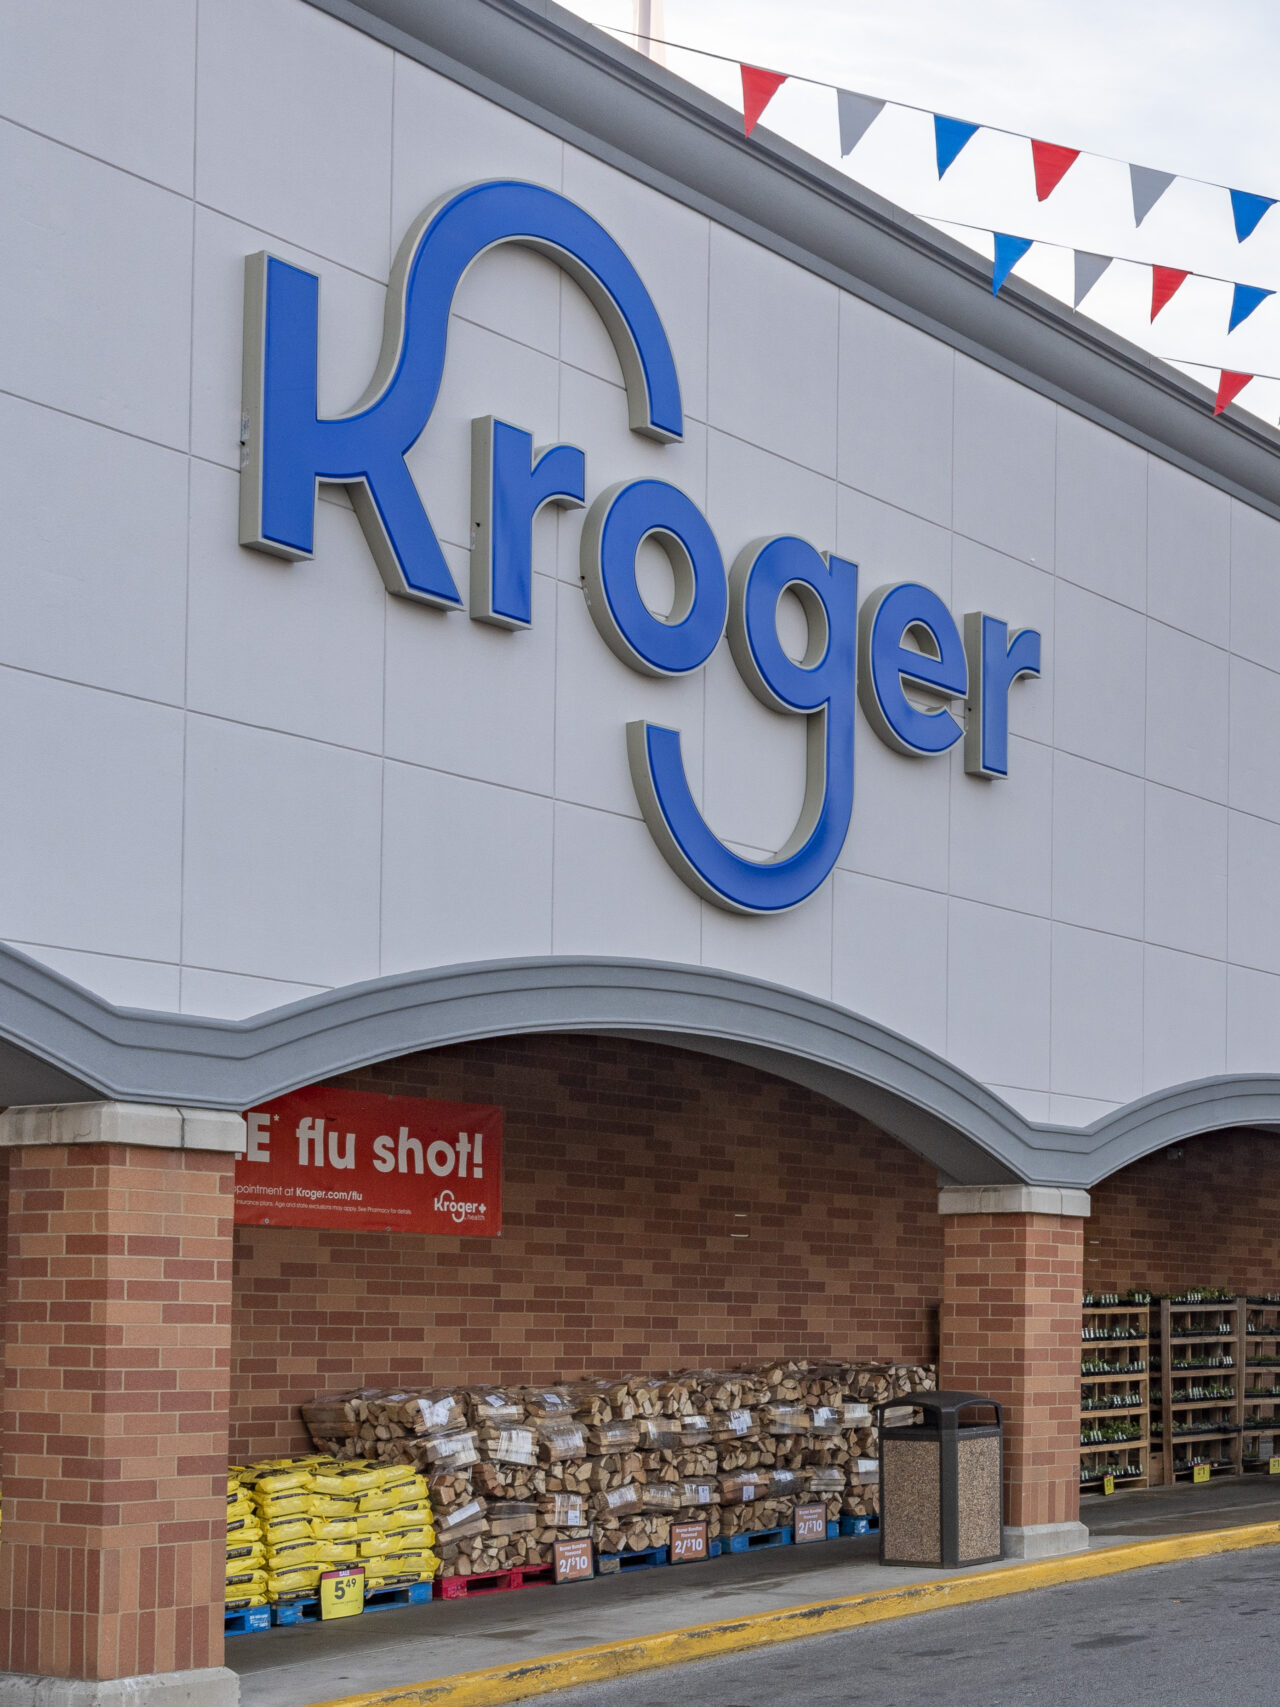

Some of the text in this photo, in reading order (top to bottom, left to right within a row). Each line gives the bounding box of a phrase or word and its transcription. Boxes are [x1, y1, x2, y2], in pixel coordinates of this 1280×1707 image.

[239, 177, 1041, 915] Kroger
[296, 1117, 356, 1170] flu
[373, 1126, 483, 1179] shot!
[284, 1187, 294, 1197] at
[296, 1187, 363, 1201] Kroger.com/flu
[798, 1520, 823, 1535] 2/$10
[674, 1538, 703, 1554] 2/$10
[559, 1556, 588, 1573] 2/$10
